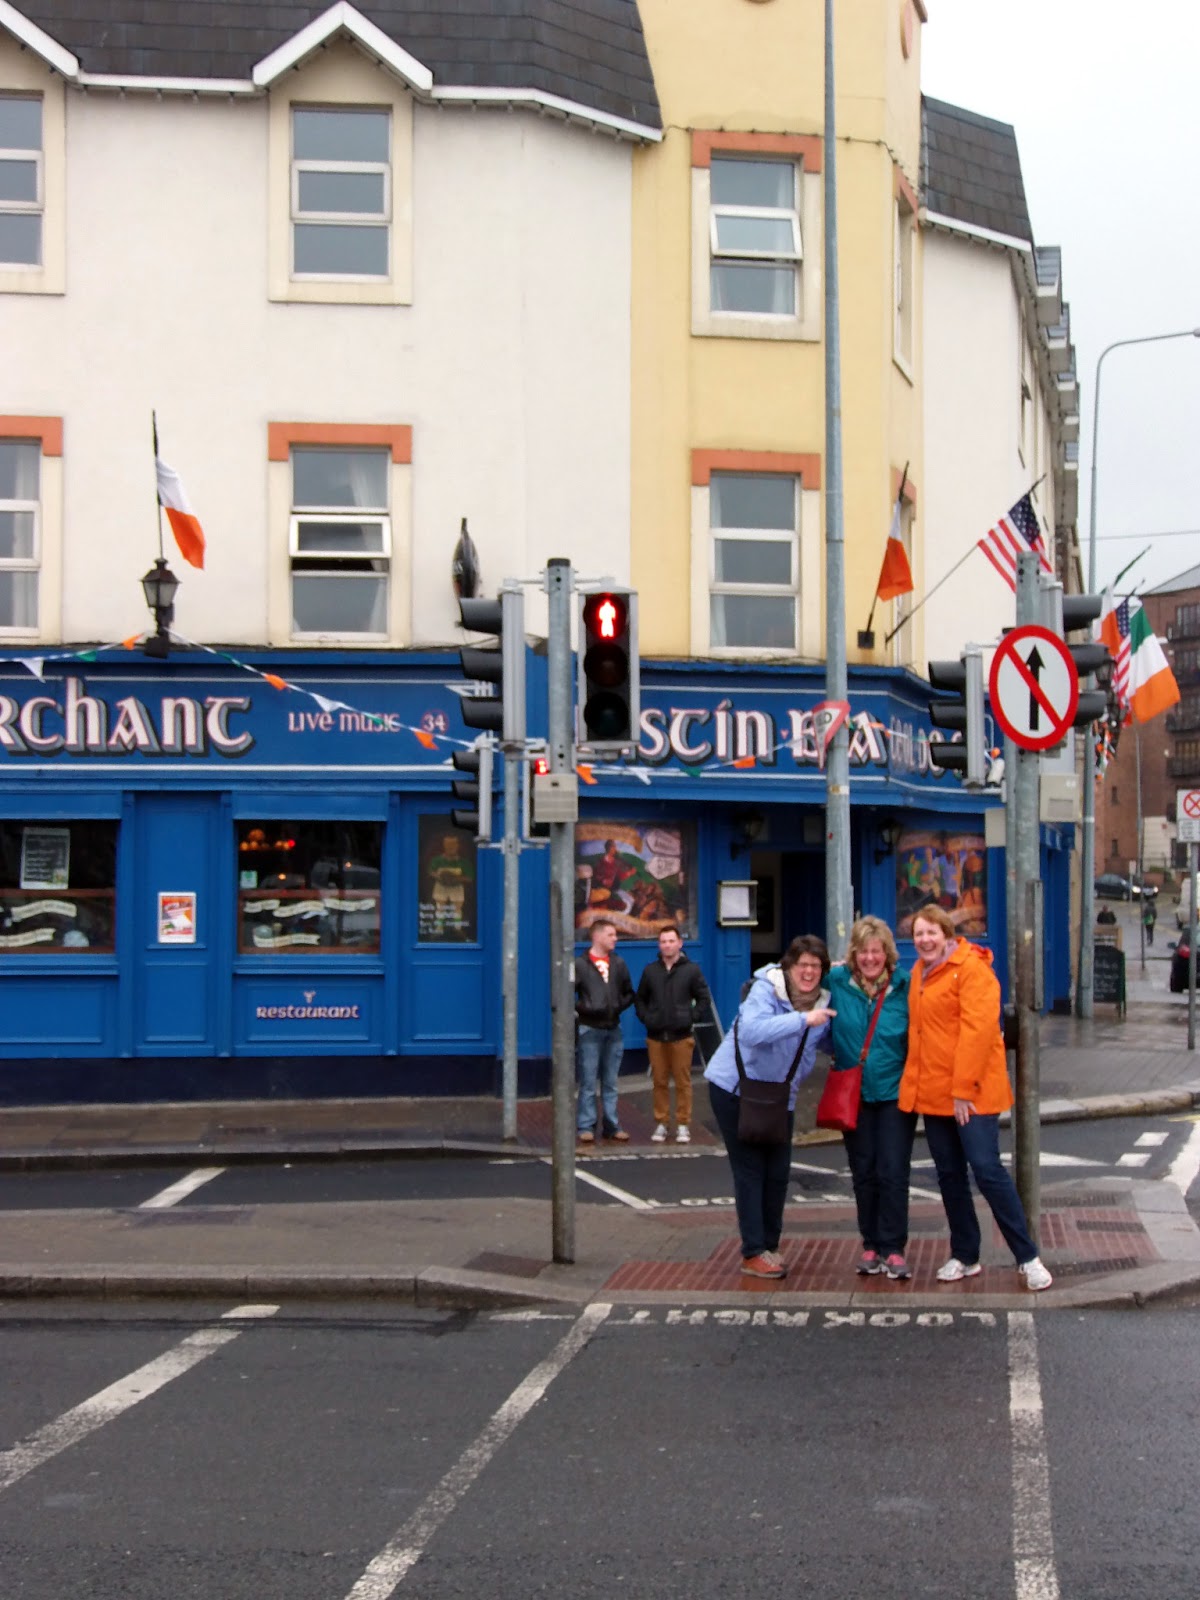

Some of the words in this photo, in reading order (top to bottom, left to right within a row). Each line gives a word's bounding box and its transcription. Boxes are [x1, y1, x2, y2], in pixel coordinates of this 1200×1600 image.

[422, 713, 446, 732] 34
[605, 1308, 810, 1328] RIGHT
[823, 1309, 997, 1329] LOOK
